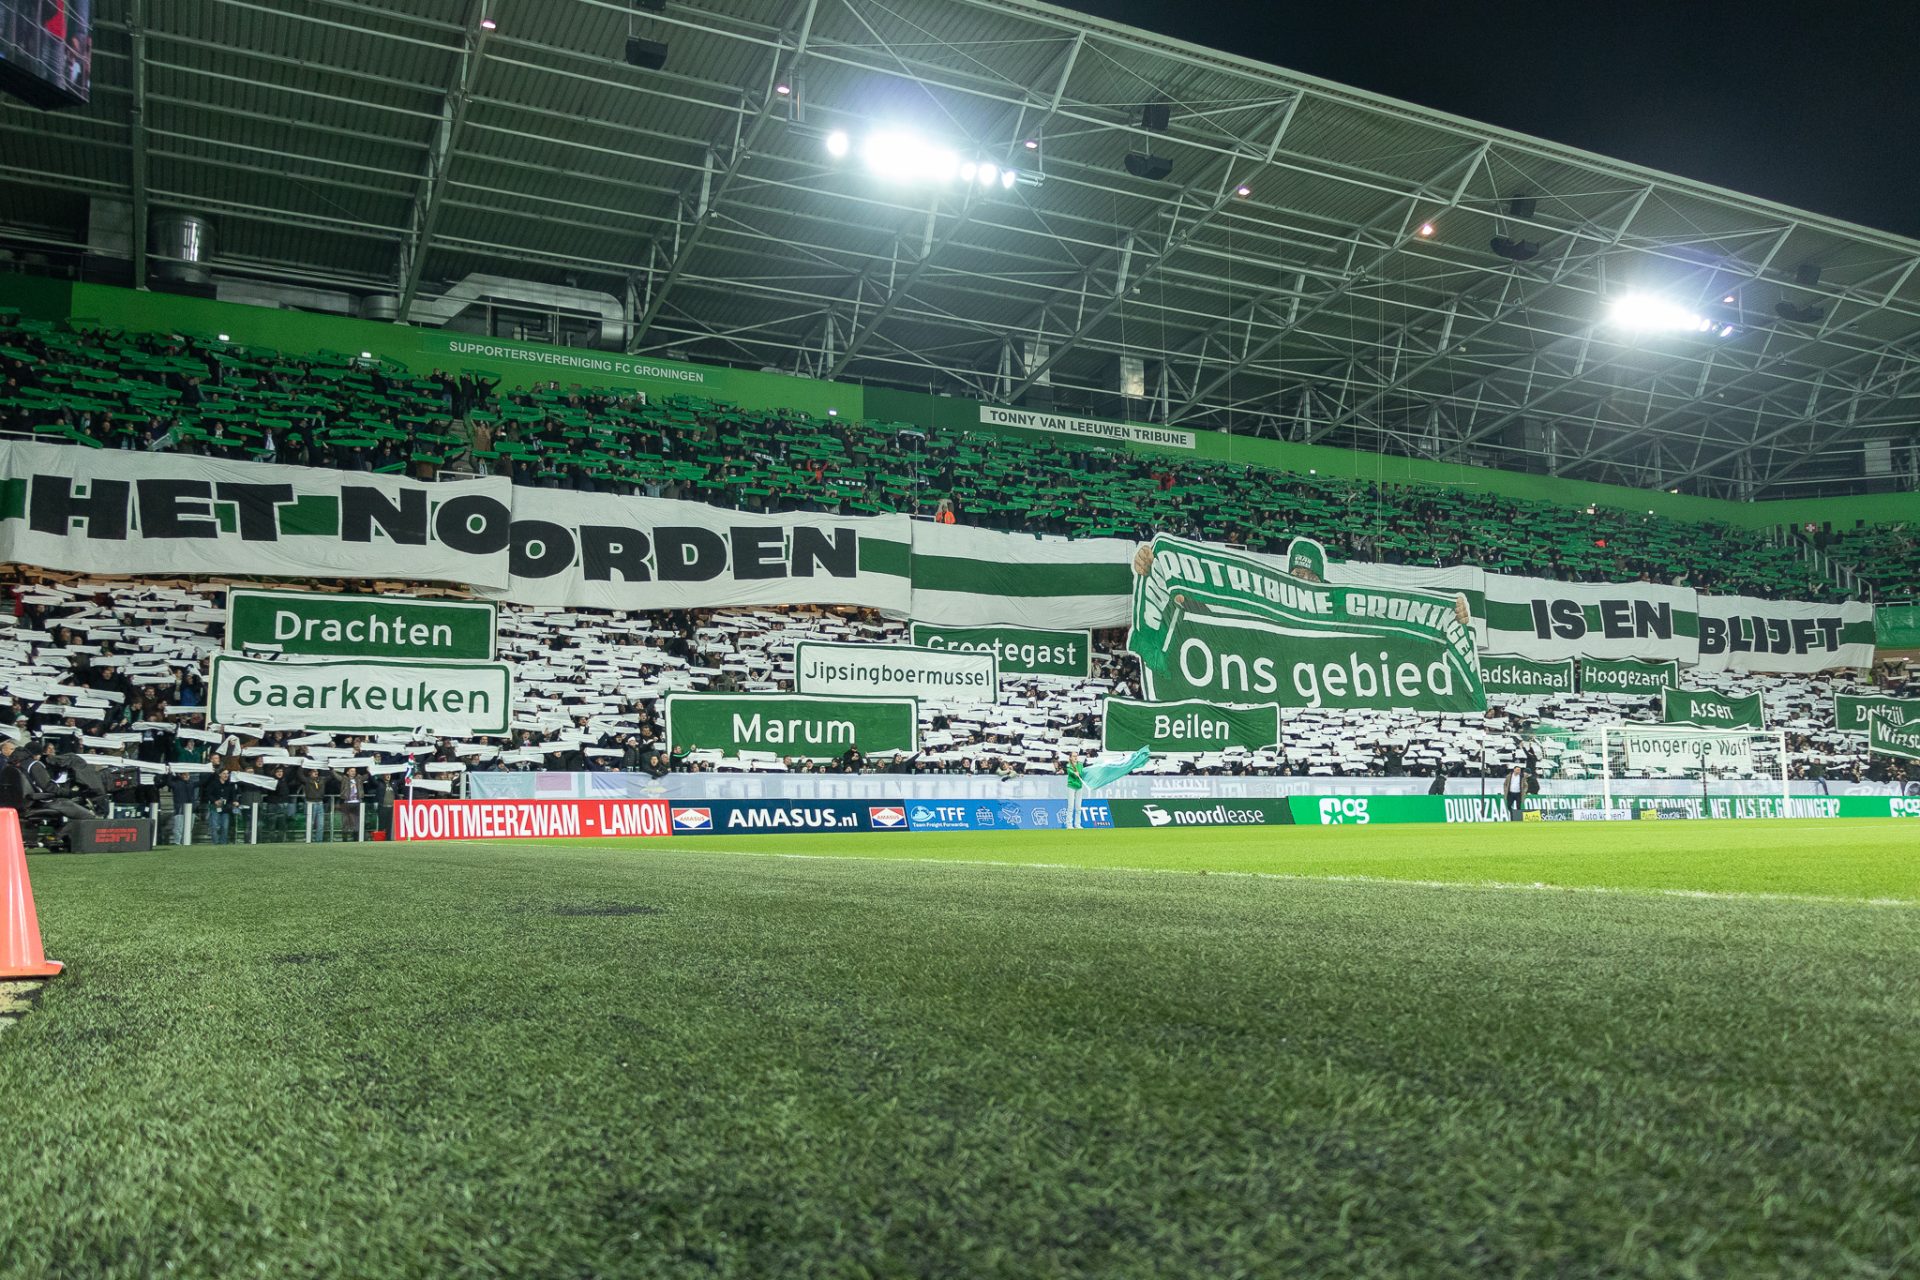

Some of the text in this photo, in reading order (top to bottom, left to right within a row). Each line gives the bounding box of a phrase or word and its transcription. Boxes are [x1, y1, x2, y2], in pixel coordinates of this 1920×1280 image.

[450, 341, 704, 383] SUPPORTERSVERENIGING FC GRONINGEN
[990, 410, 1187, 445] TONNY VAN LEEUWEN TRIBUNE
[29, 475, 857, 582] HET NOORDEN
[274, 610, 453, 647] Drachten
[1531, 599, 1843, 655] IS EN BLIJFT
[805, 661, 991, 686] Jipsingboermussel
[1179, 637, 1454, 708] Ons gebied
[1585, 662, 1669, 689] Hoogezand
[233, 675, 490, 714] Gaarkeuken
[1690, 700, 1734, 720] Assen
[732, 713, 856, 745] Marum
[1154, 713, 1230, 741] Beilen
[1630, 738, 1712, 759] Hongerige
[400, 804, 581, 838] NOOITMEERZWAM
[599, 803, 668, 837] LAMON
[728, 808, 858, 828] AMASUS.nl
[936, 806, 966, 821] TFF
[1080, 806, 1108, 822] TFF
[1174, 805, 1265, 824] noordlease
[1581, 811, 1626, 821] Auto ken?
[1709, 798, 1731, 818] NET
[1735, 798, 1756, 818] ALS
[1775, 798, 1840, 818] GONINGEN?
[96, 828, 137, 843] ESPN
